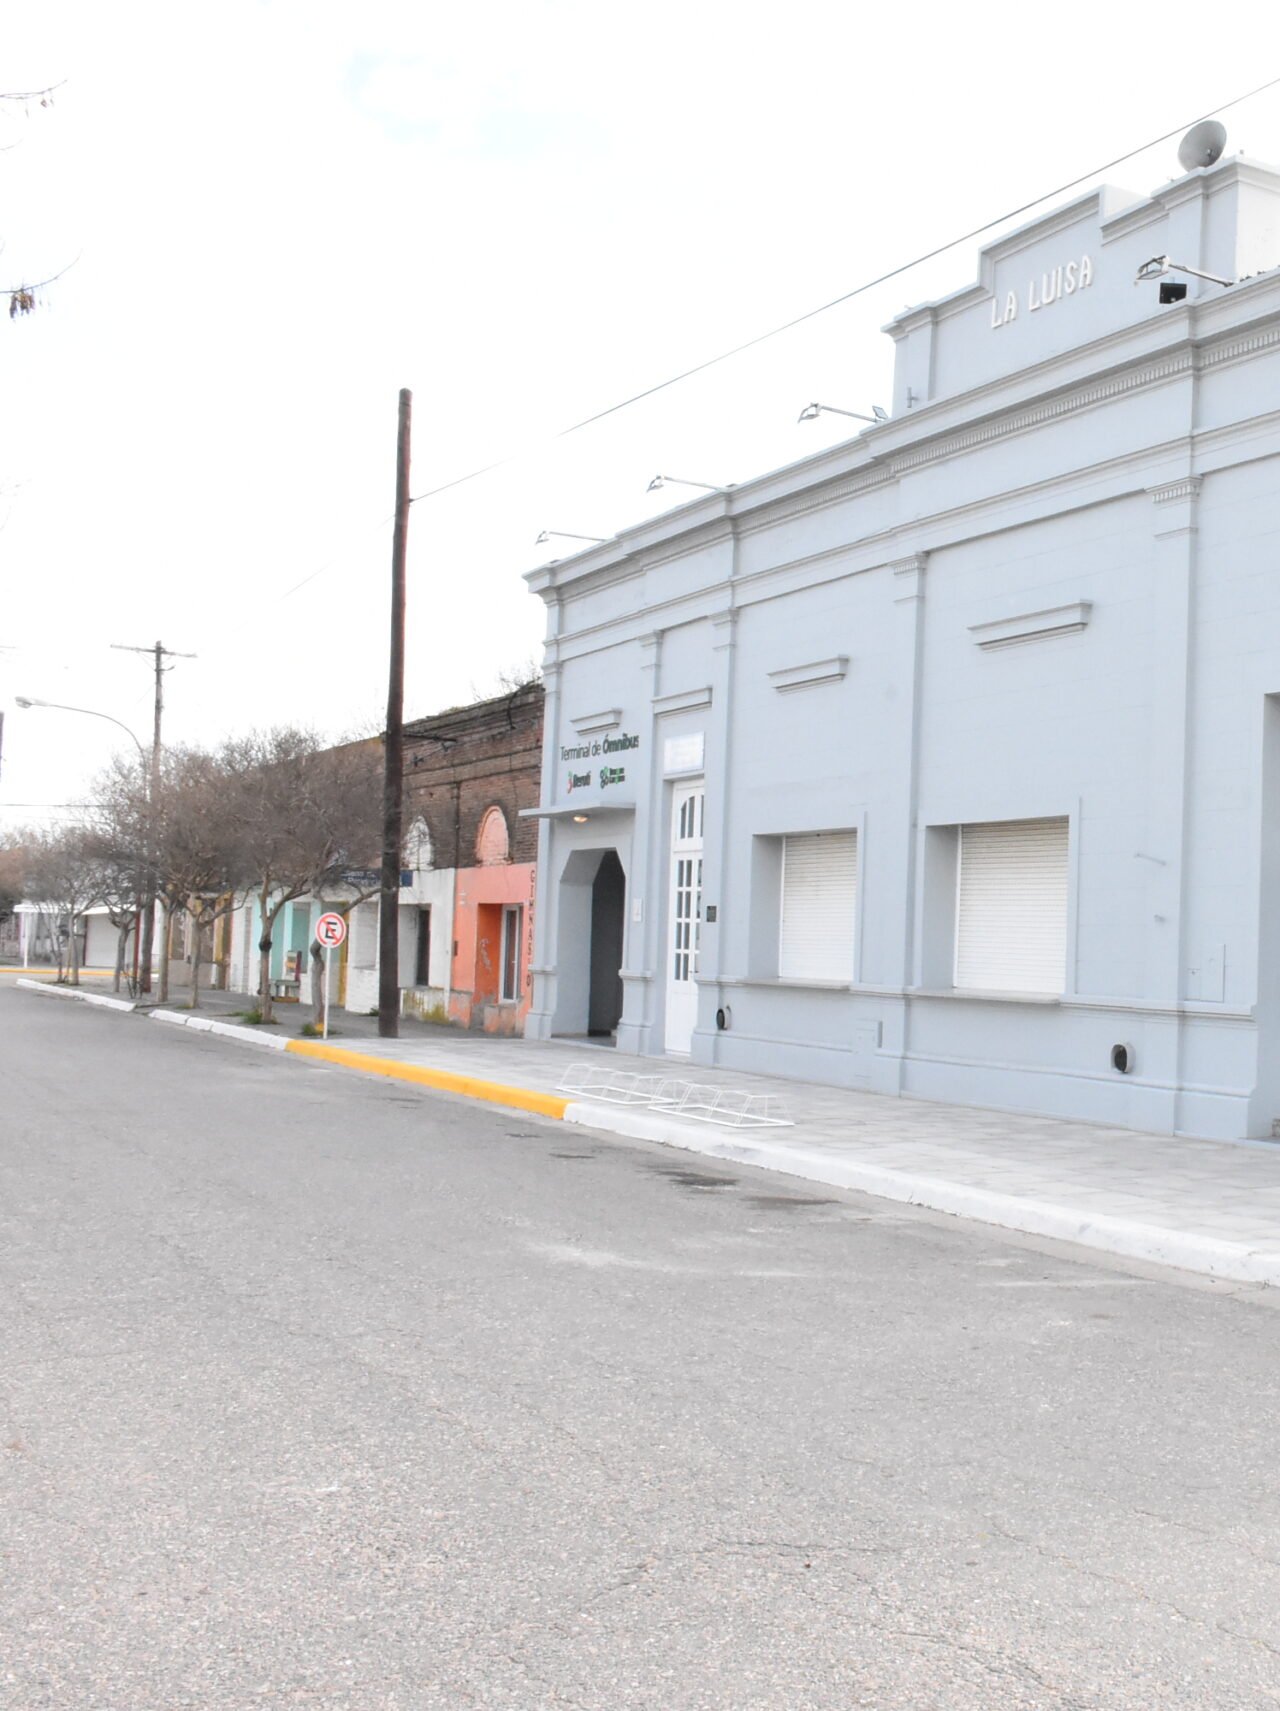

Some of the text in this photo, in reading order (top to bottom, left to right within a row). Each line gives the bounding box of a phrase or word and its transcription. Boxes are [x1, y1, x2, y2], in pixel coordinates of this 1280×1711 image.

[991, 254, 1094, 329] LA LUISA
[560, 732, 640, 761] Terminal de Ómnibus
[325, 921, 338, 939] E
